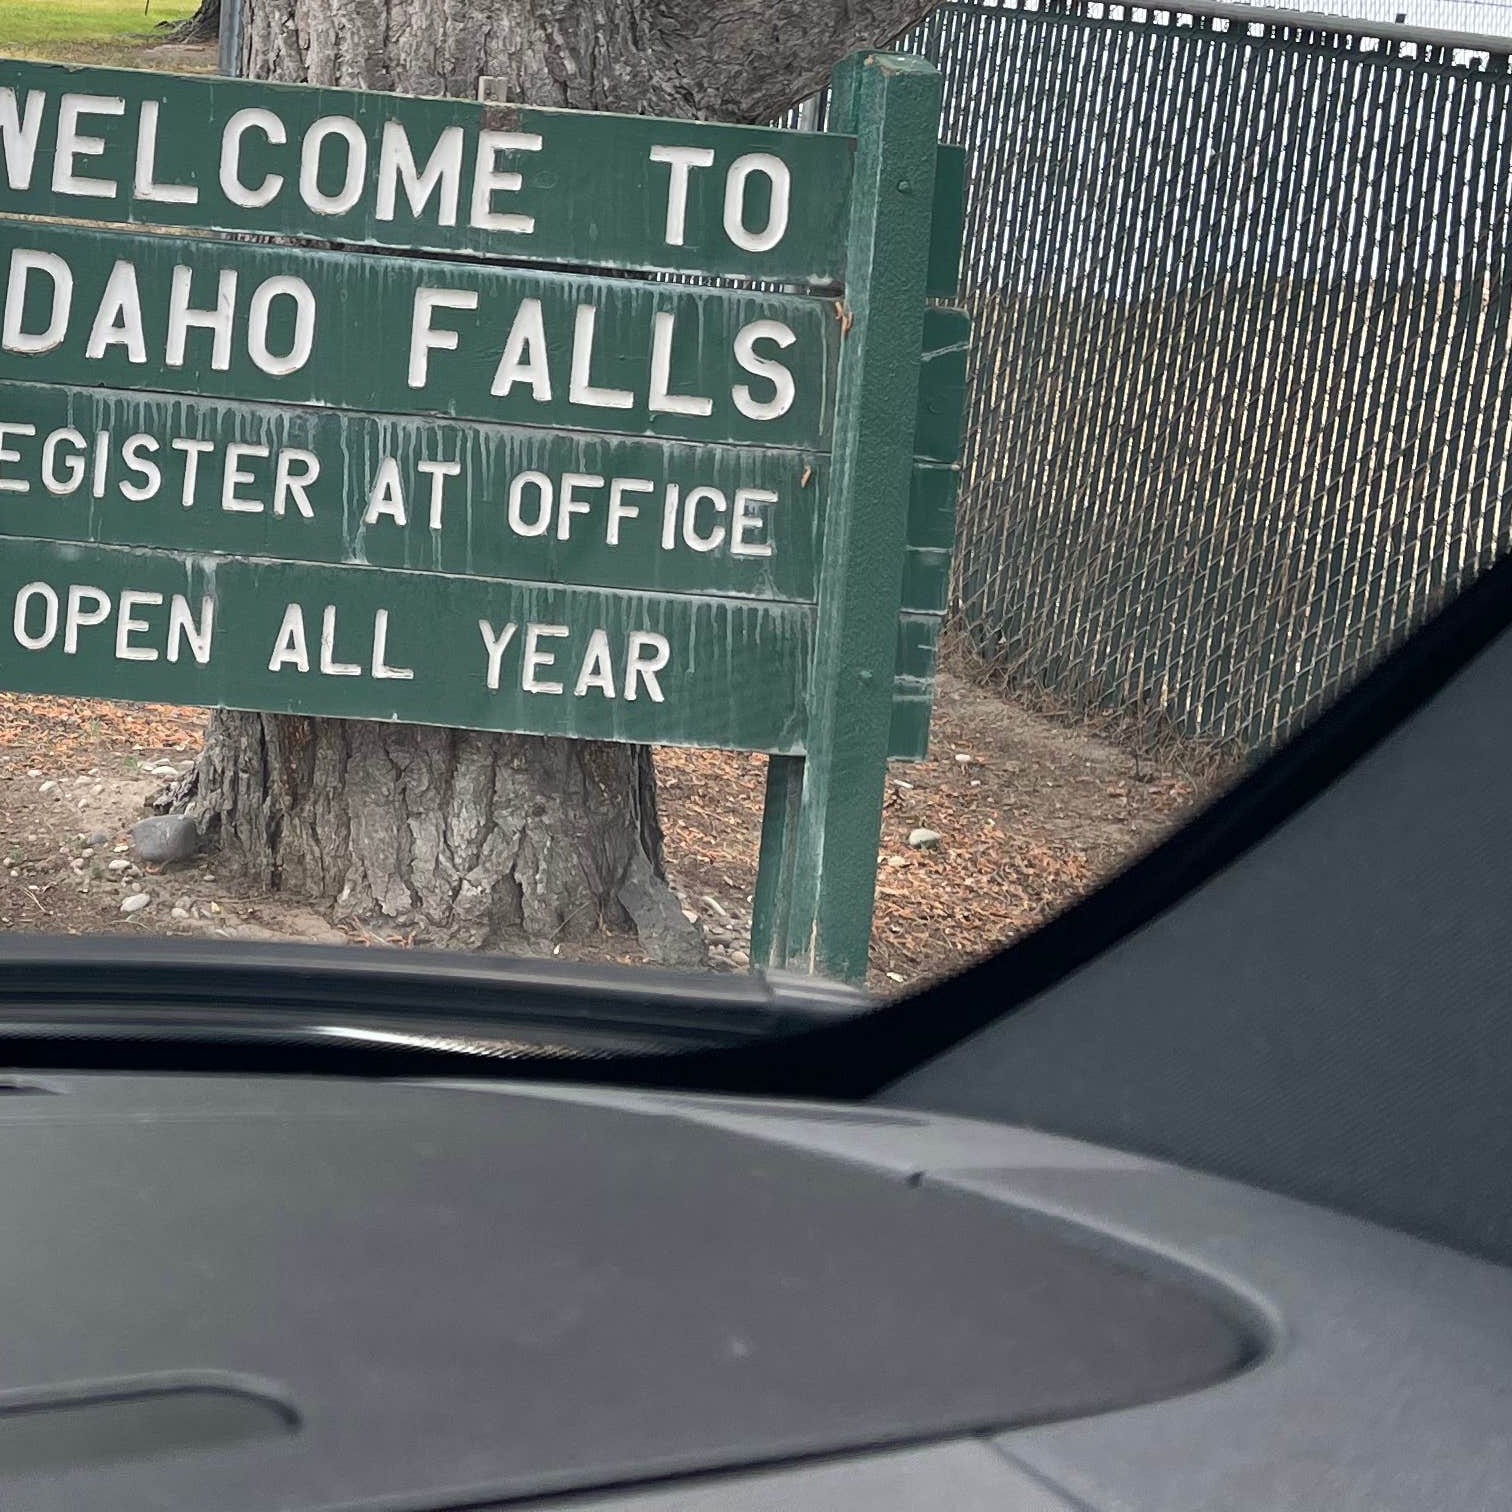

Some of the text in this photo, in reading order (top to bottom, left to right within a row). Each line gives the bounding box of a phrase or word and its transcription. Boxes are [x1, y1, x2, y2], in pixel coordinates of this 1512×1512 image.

[649, 145, 792, 253] TO
[406, 287, 798, 422] FALLS
[364, 457, 462, 531] AT
[507, 470, 780, 558] OFFICE
[12, 581, 671, 704] OPEN ALL YEAR
